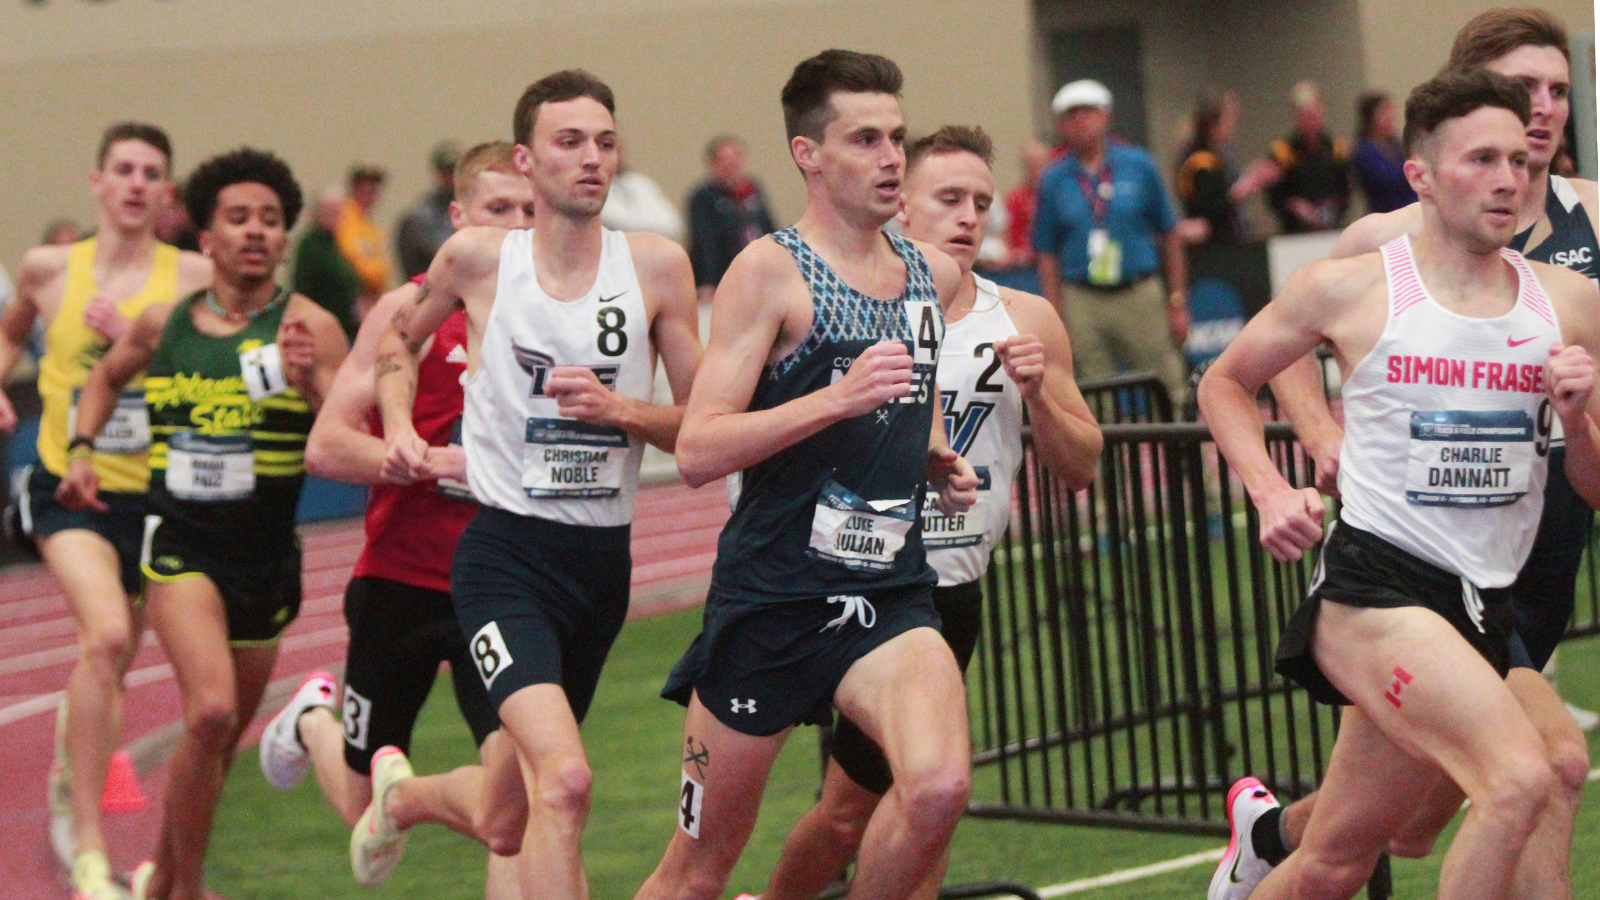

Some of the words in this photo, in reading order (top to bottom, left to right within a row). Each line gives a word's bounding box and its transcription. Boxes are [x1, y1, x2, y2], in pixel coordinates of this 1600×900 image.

[596, 306, 628, 357] 8
[917, 305, 939, 361] 4
[973, 342, 1004, 393] 2
[1386, 355, 1466, 388] SIMON
[1471, 361, 1547, 394] FRASE
[544, 449, 609, 463] CHRISTIAN
[1440, 447, 1503, 463] CHARLIE
[551, 466, 599, 483] NOBLE
[1428, 467, 1511, 488] DANNATT
[845, 516, 875, 532] LUKE
[921, 514, 966, 532] UTTER
[833, 532, 885, 555] JULIAN
[474, 633, 502, 680] 8
[680, 779, 696, 830] 4
